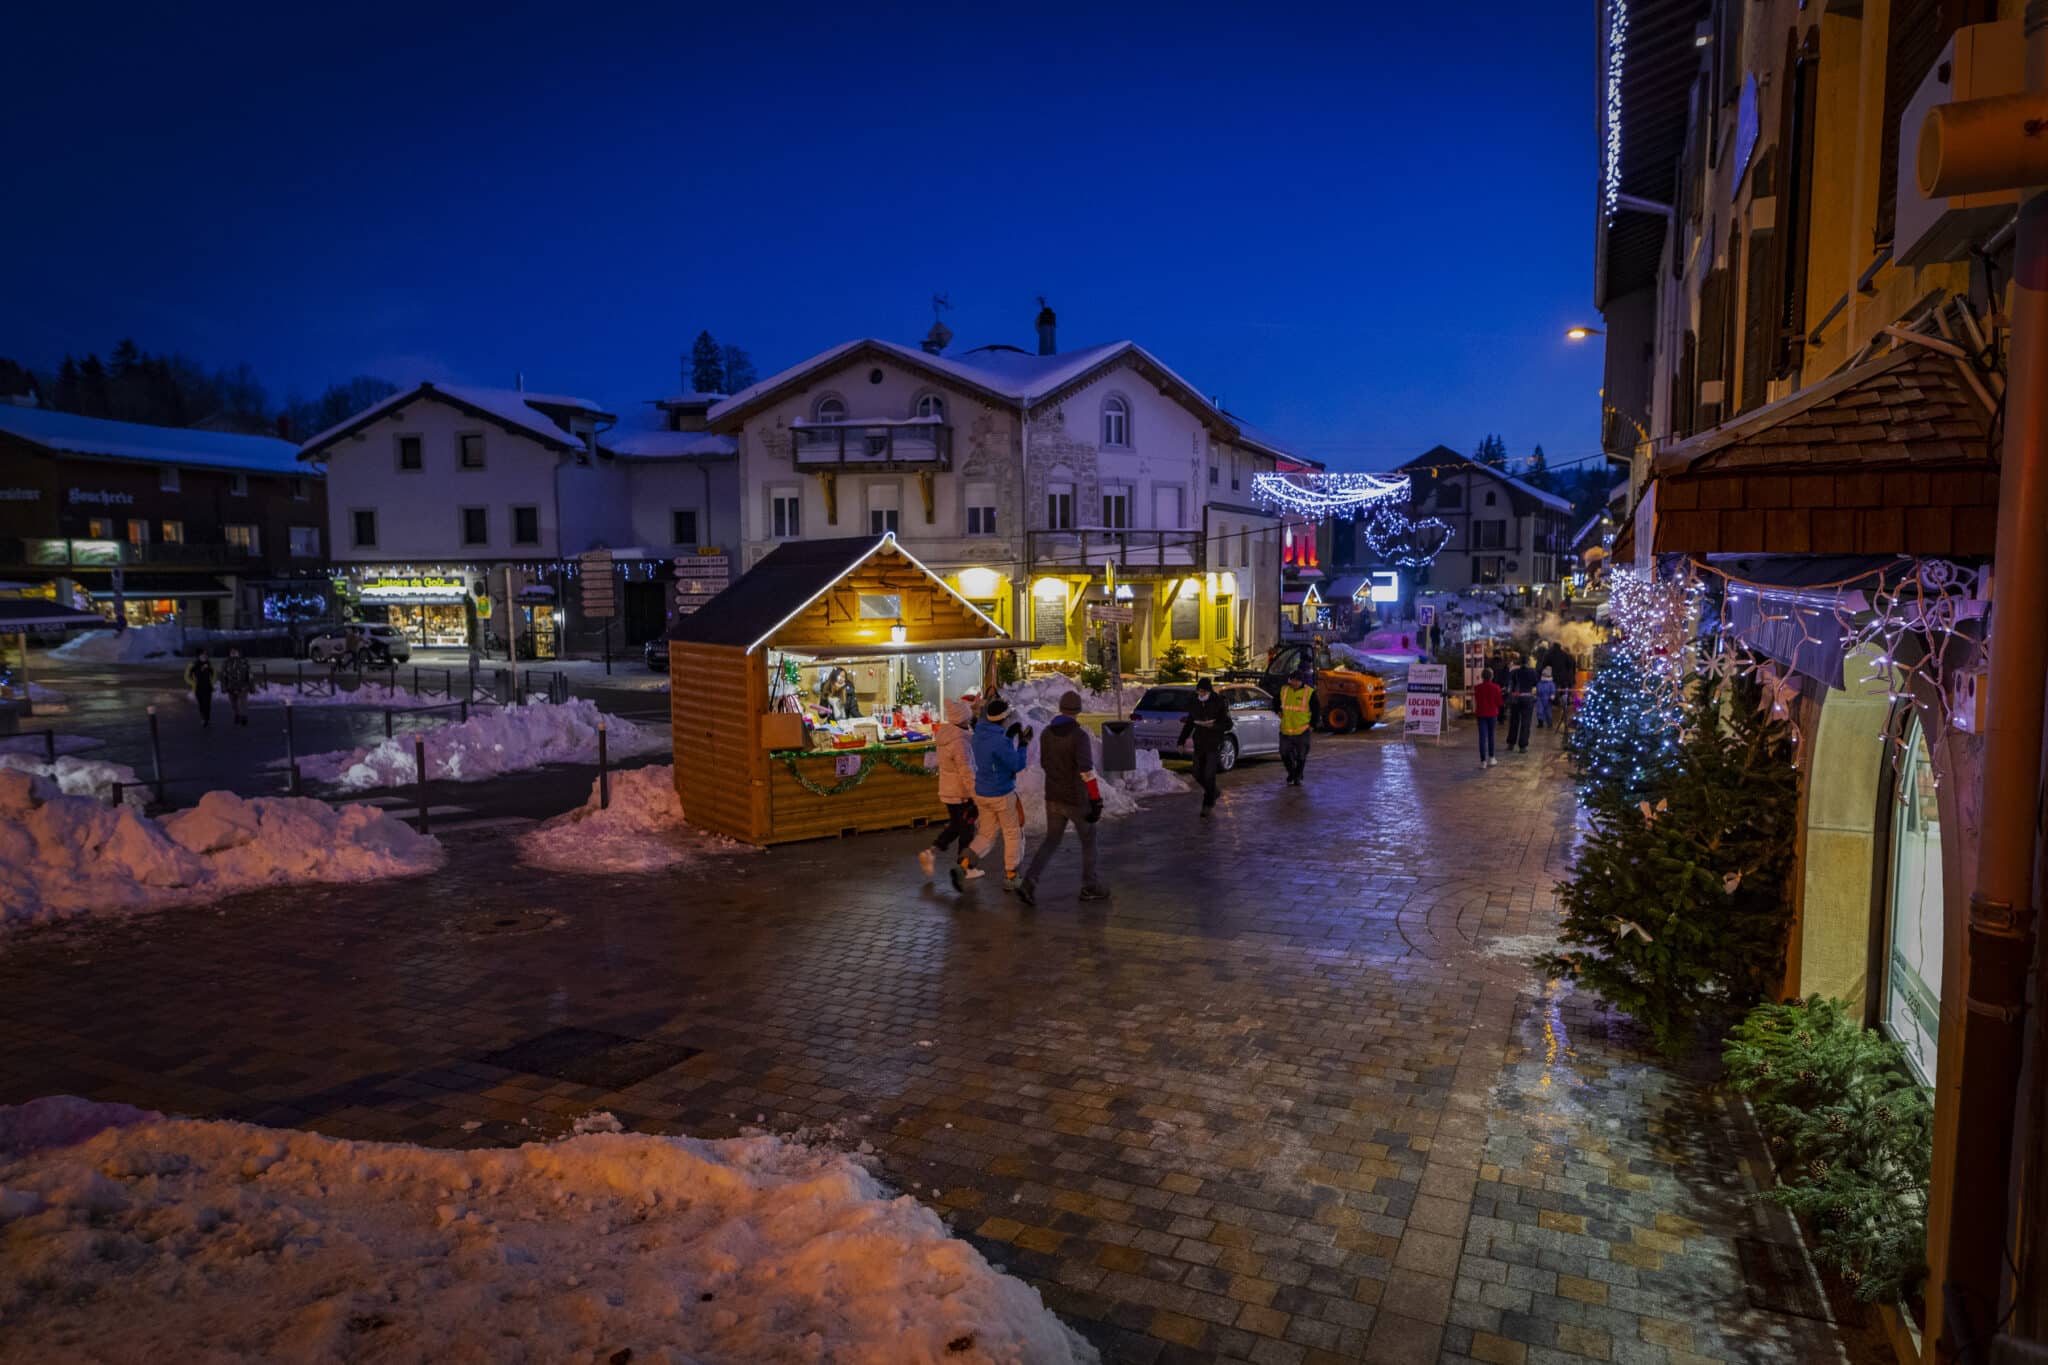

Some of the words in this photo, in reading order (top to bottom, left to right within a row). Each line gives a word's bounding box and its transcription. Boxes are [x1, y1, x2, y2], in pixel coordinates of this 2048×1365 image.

[378, 577, 409, 588] Histoire
[411, 578, 422, 587] de
[1408, 698, 1440, 707] LOCATION
[1411, 707, 1419, 716] de
[1421, 708, 1436, 717] SKIS
